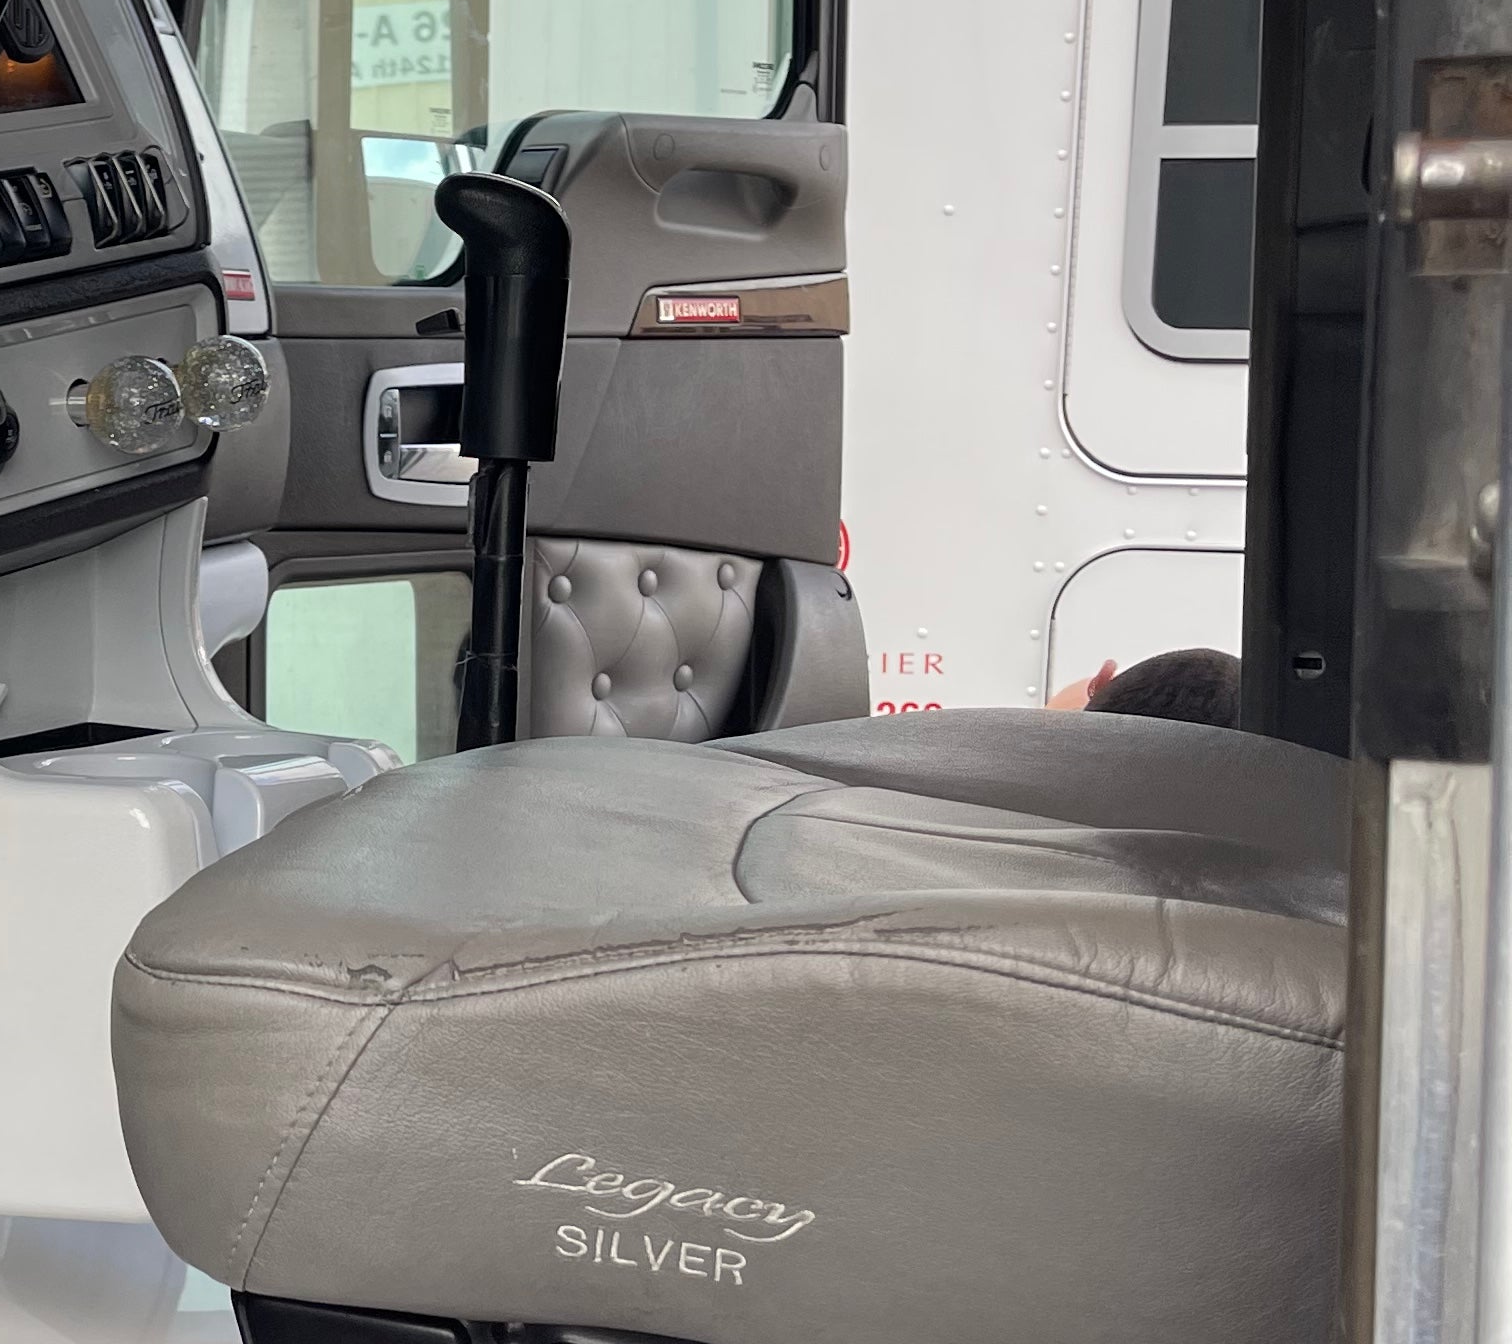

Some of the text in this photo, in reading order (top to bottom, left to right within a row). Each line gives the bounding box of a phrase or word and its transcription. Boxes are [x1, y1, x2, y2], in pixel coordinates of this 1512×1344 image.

[674, 302, 737, 318] KENWORTH
[880, 652, 944, 675] IER
[513, 1153, 816, 1242] Legacy
[555, 1224, 747, 1285] SILVER
